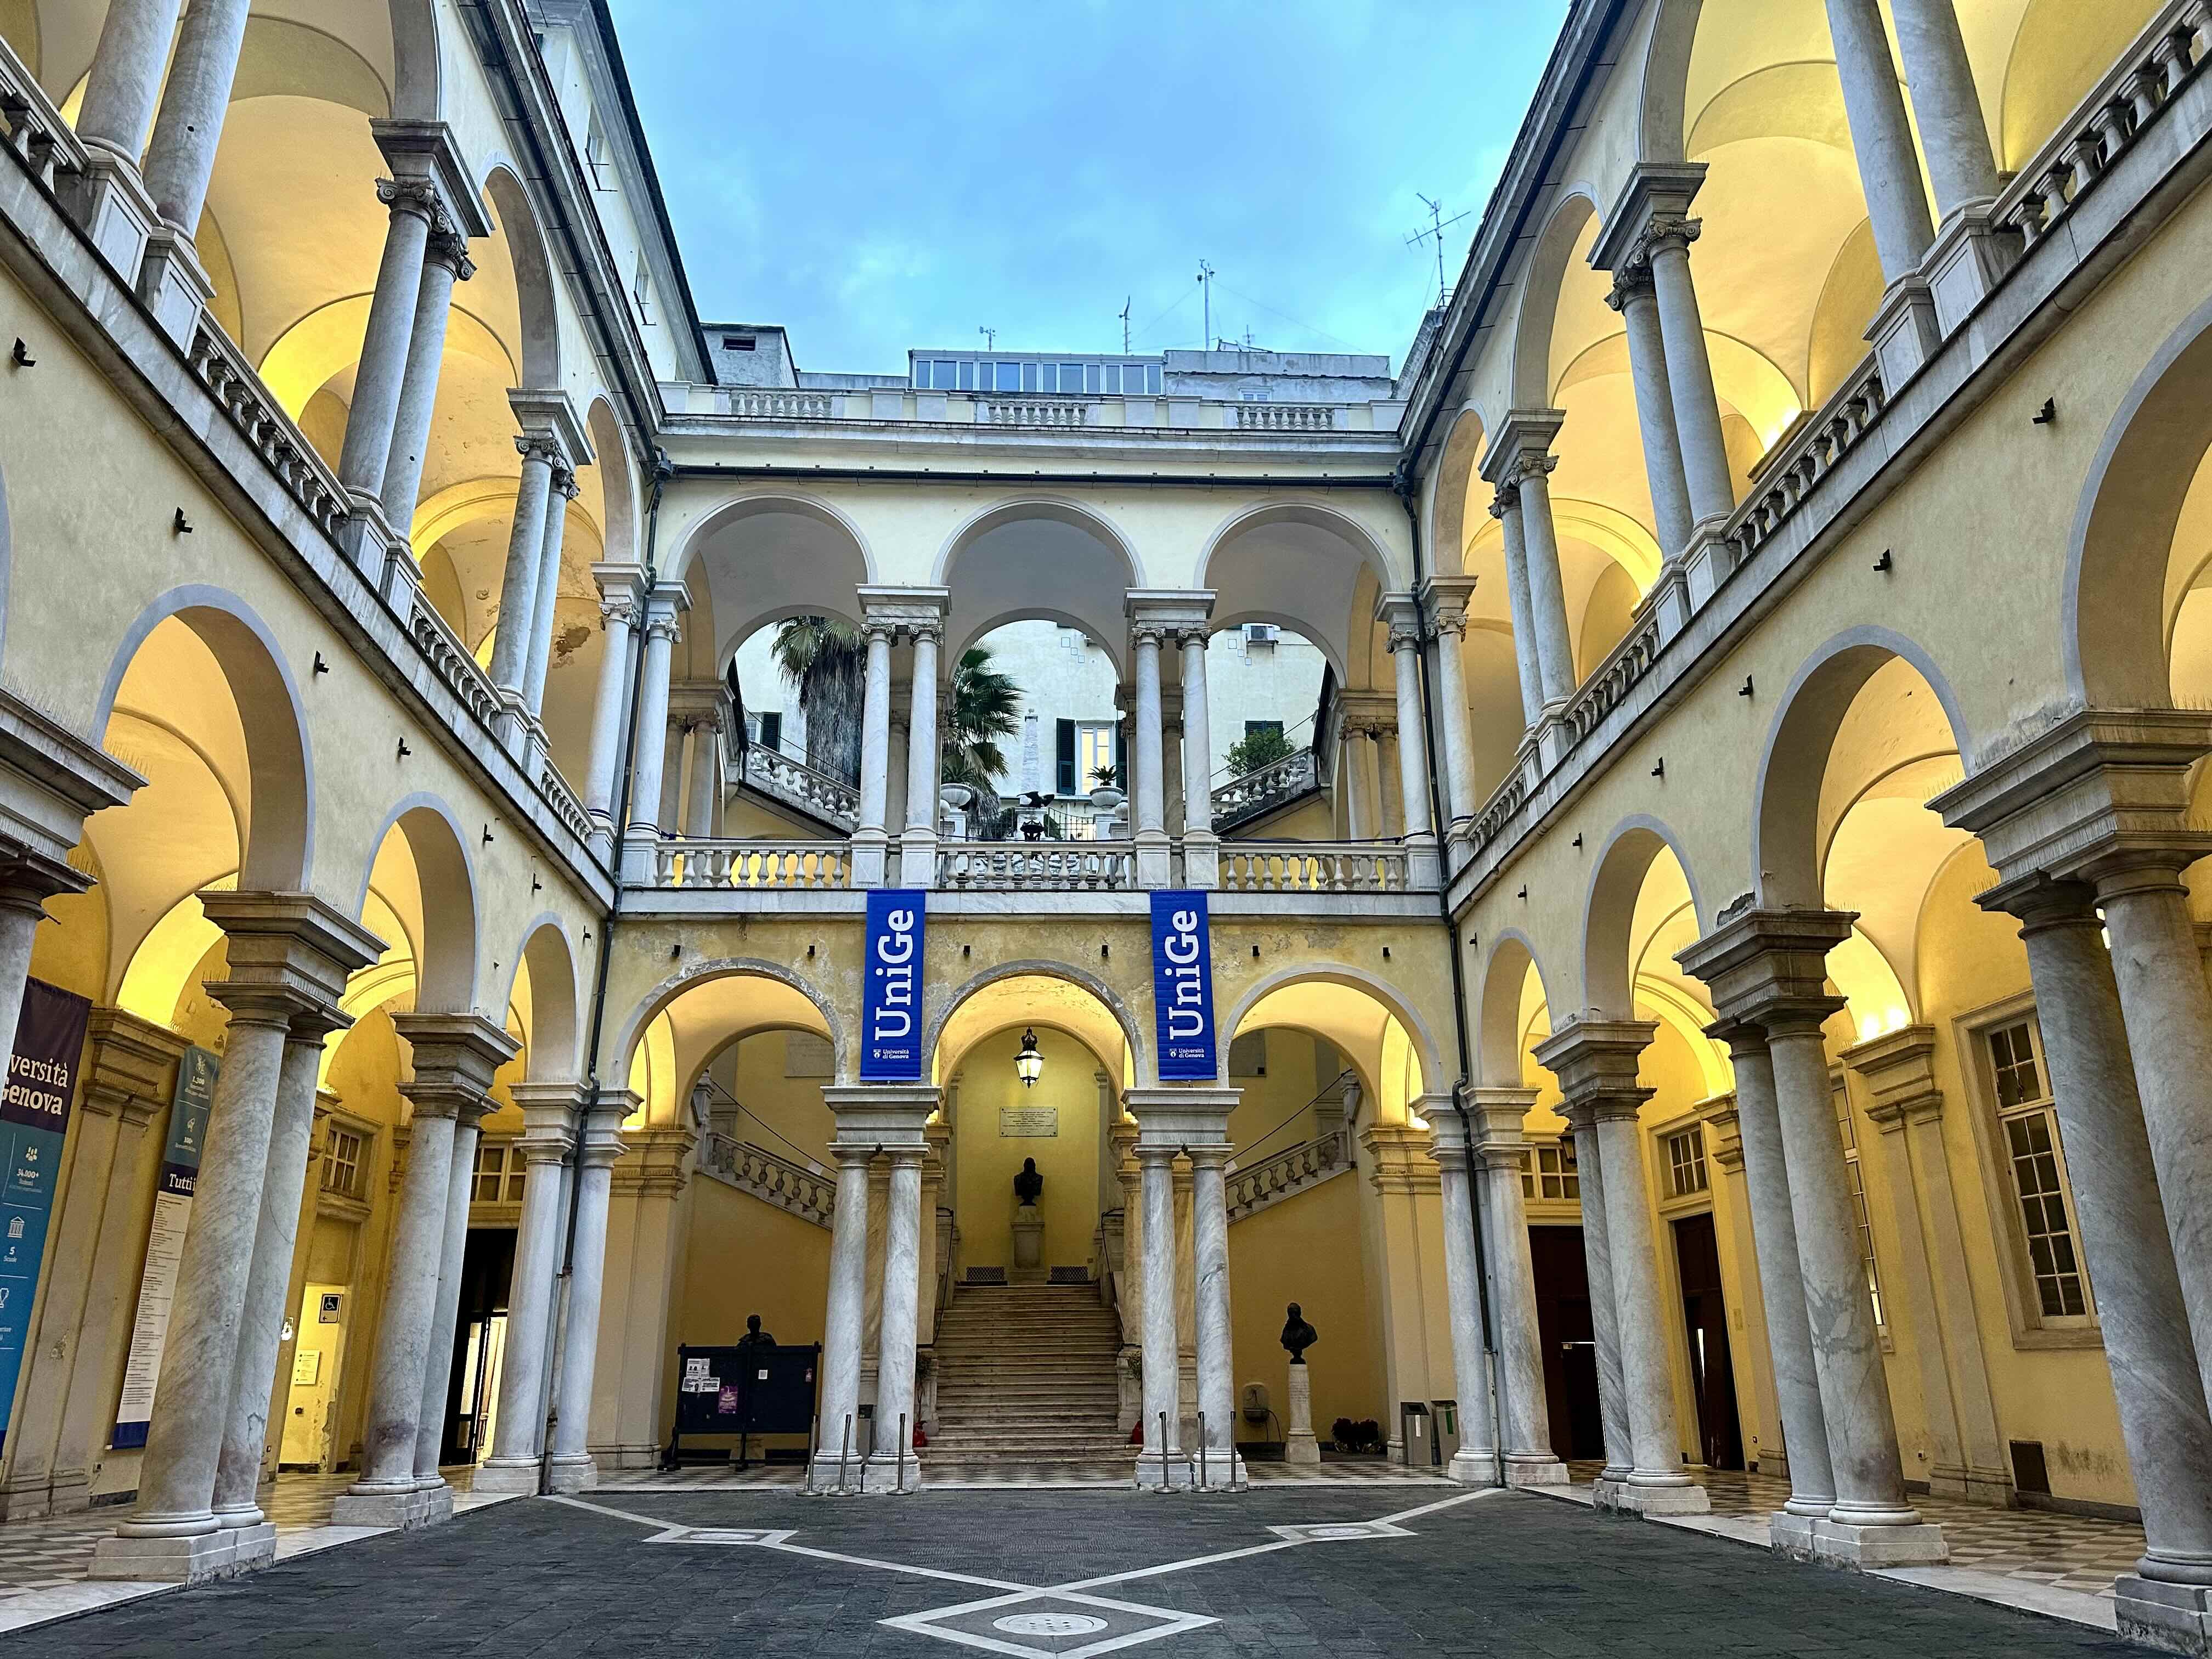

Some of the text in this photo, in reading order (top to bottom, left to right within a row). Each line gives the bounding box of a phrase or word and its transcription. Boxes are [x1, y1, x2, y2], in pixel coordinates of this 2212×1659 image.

[875, 910, 913, 1041] UniGe
[1165, 911, 1203, 1040] UniGe
[169, 1173, 193, 1191] Tutti
[9, 1246, 15, 1255] 5
